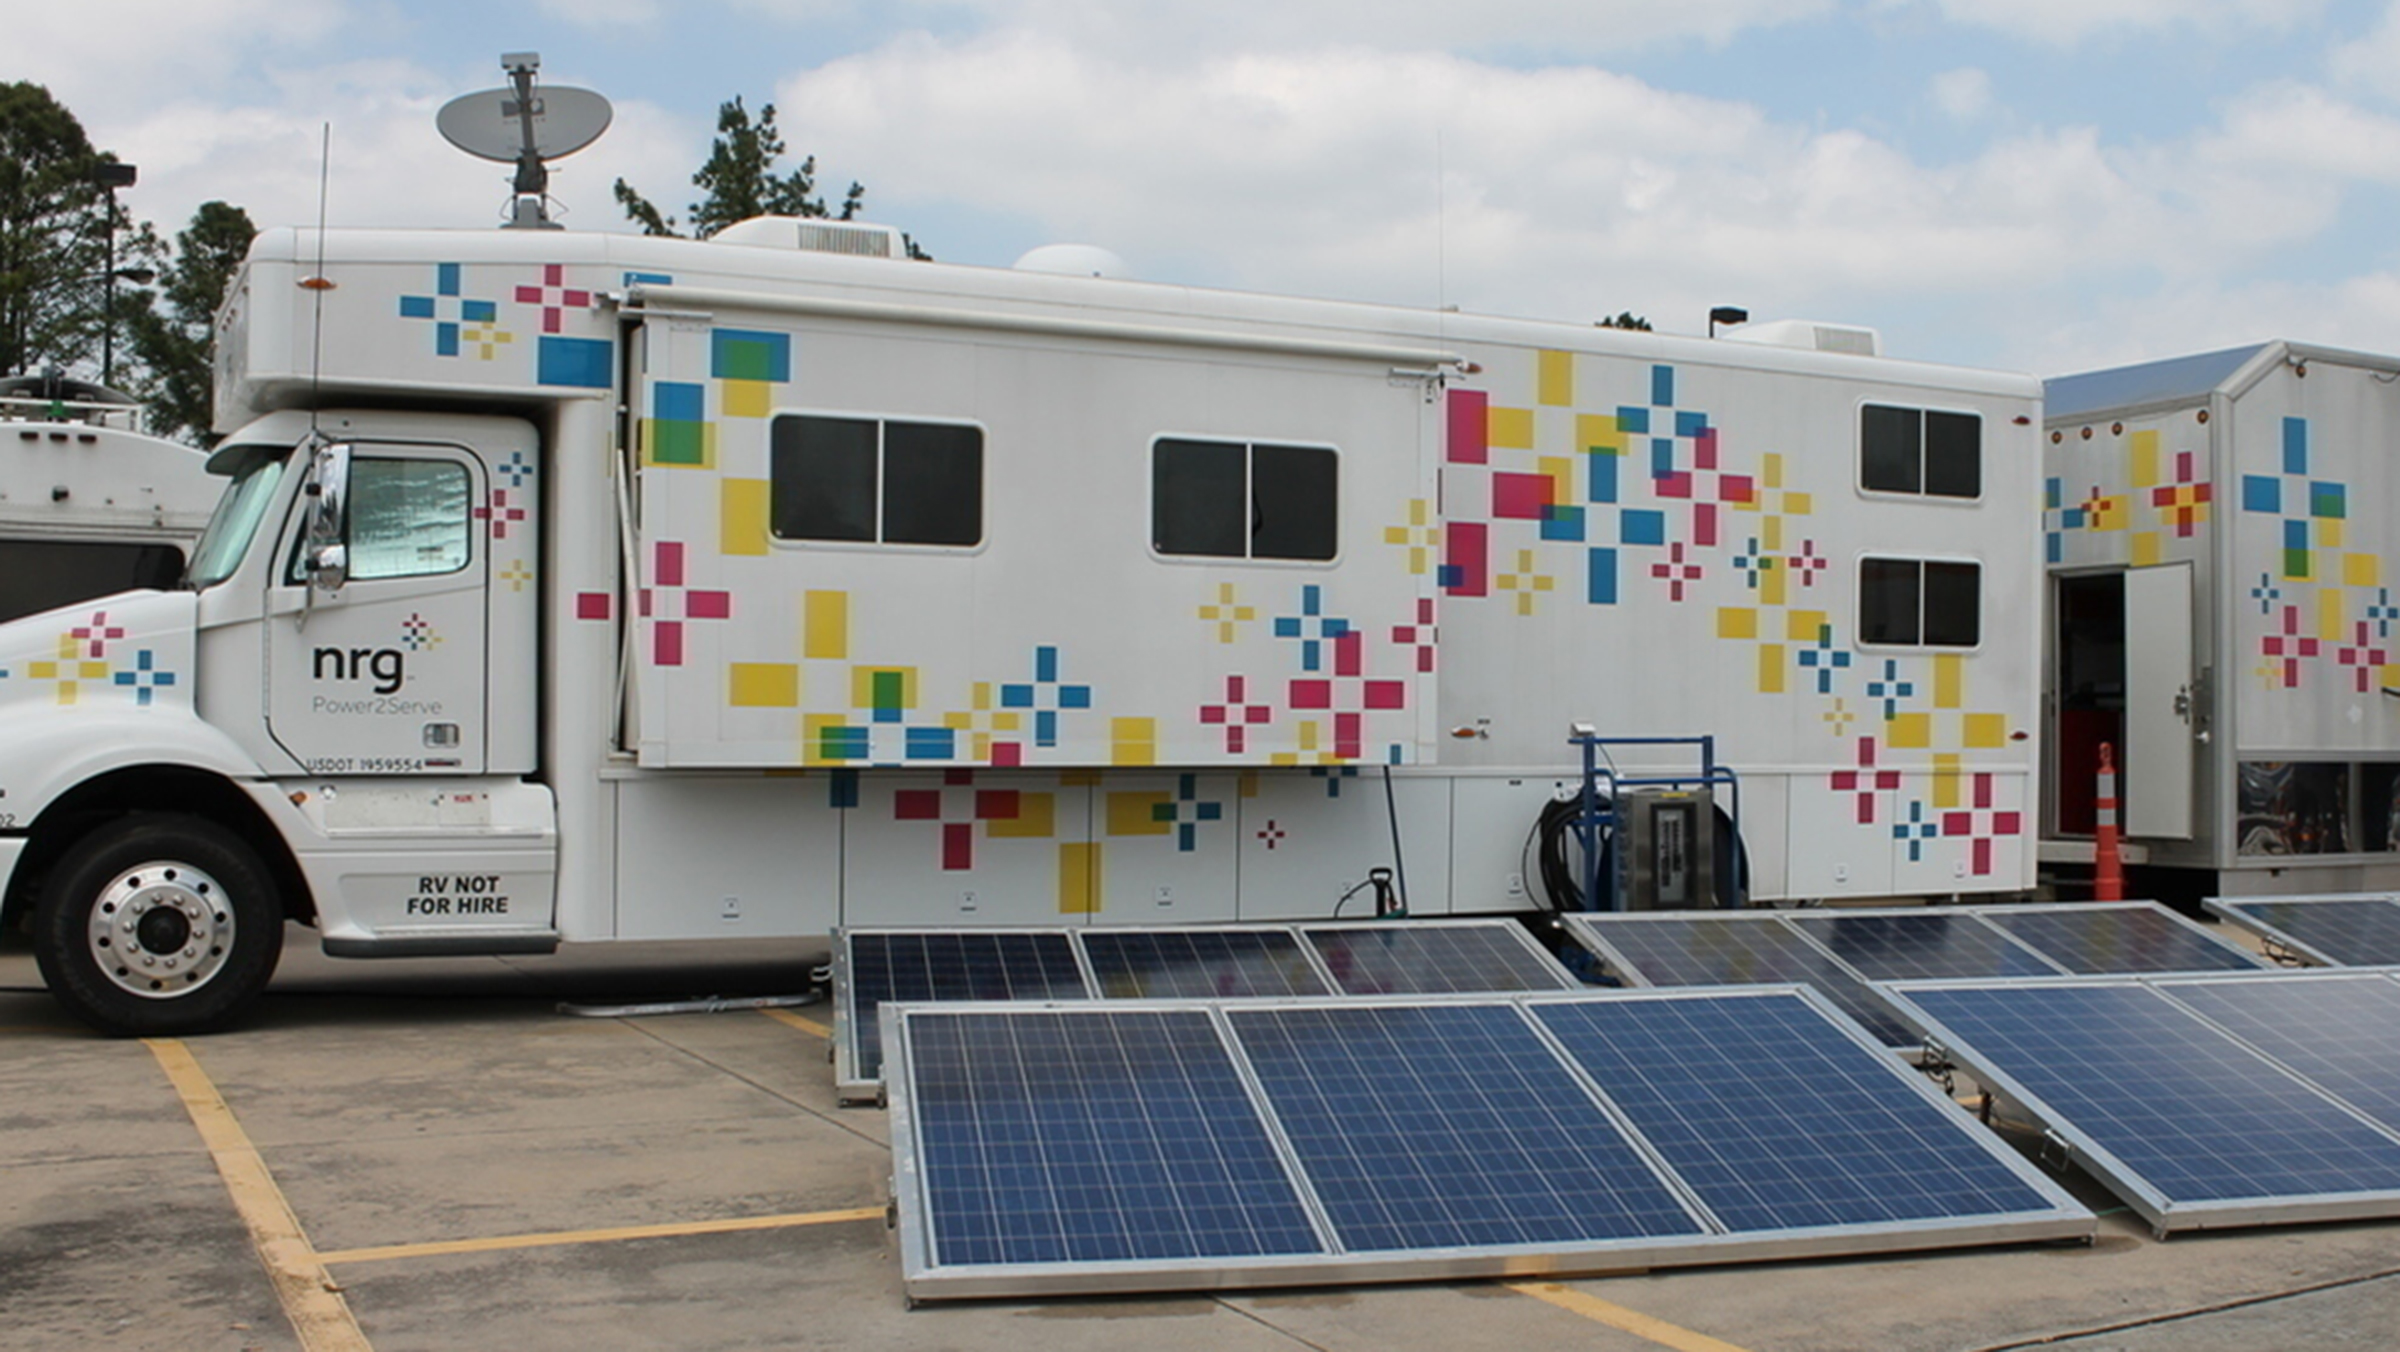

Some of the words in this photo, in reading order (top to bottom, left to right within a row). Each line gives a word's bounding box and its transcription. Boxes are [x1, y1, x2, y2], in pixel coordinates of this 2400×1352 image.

[314, 647, 403, 694] nrg
[313, 696, 442, 715] Power2Serve
[307, 758, 354, 771] USDOT
[419, 877, 448, 893] RV
[455, 876, 500, 893] NOT
[407, 897, 450, 914] FOR
[457, 897, 508, 914] HIRE
